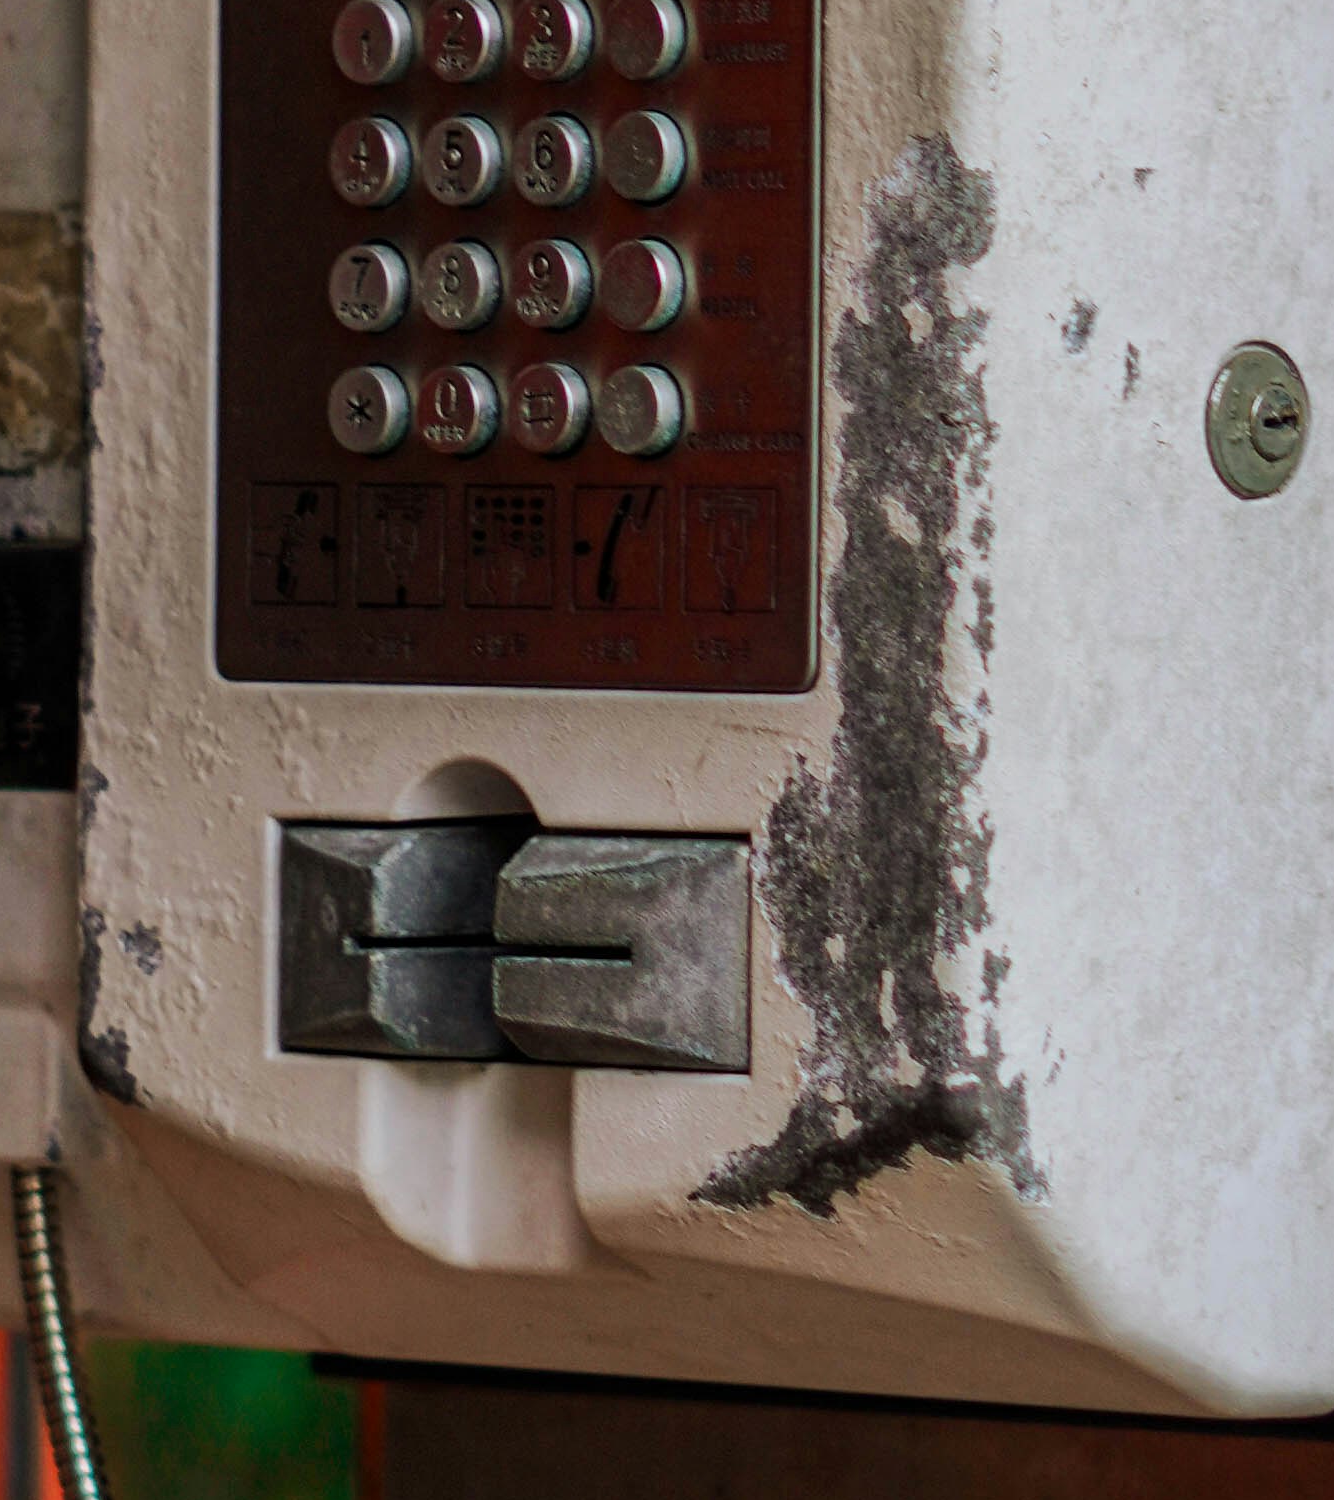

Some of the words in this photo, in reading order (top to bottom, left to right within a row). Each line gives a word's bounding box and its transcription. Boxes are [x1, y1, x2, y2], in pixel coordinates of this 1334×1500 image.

[443, 7, 464, 50] 2
[529, 5, 554, 44] 3
[358, 29, 372, 67] 1
[348, 128, 371, 173] 4
[441, 130, 464, 172] 5
[533, 130, 554, 171] 6
[349, 254, 371, 298] 7
[441, 255, 462, 295] 8
[528, 251, 551, 293] 9
[435, 378, 458, 422] 0
